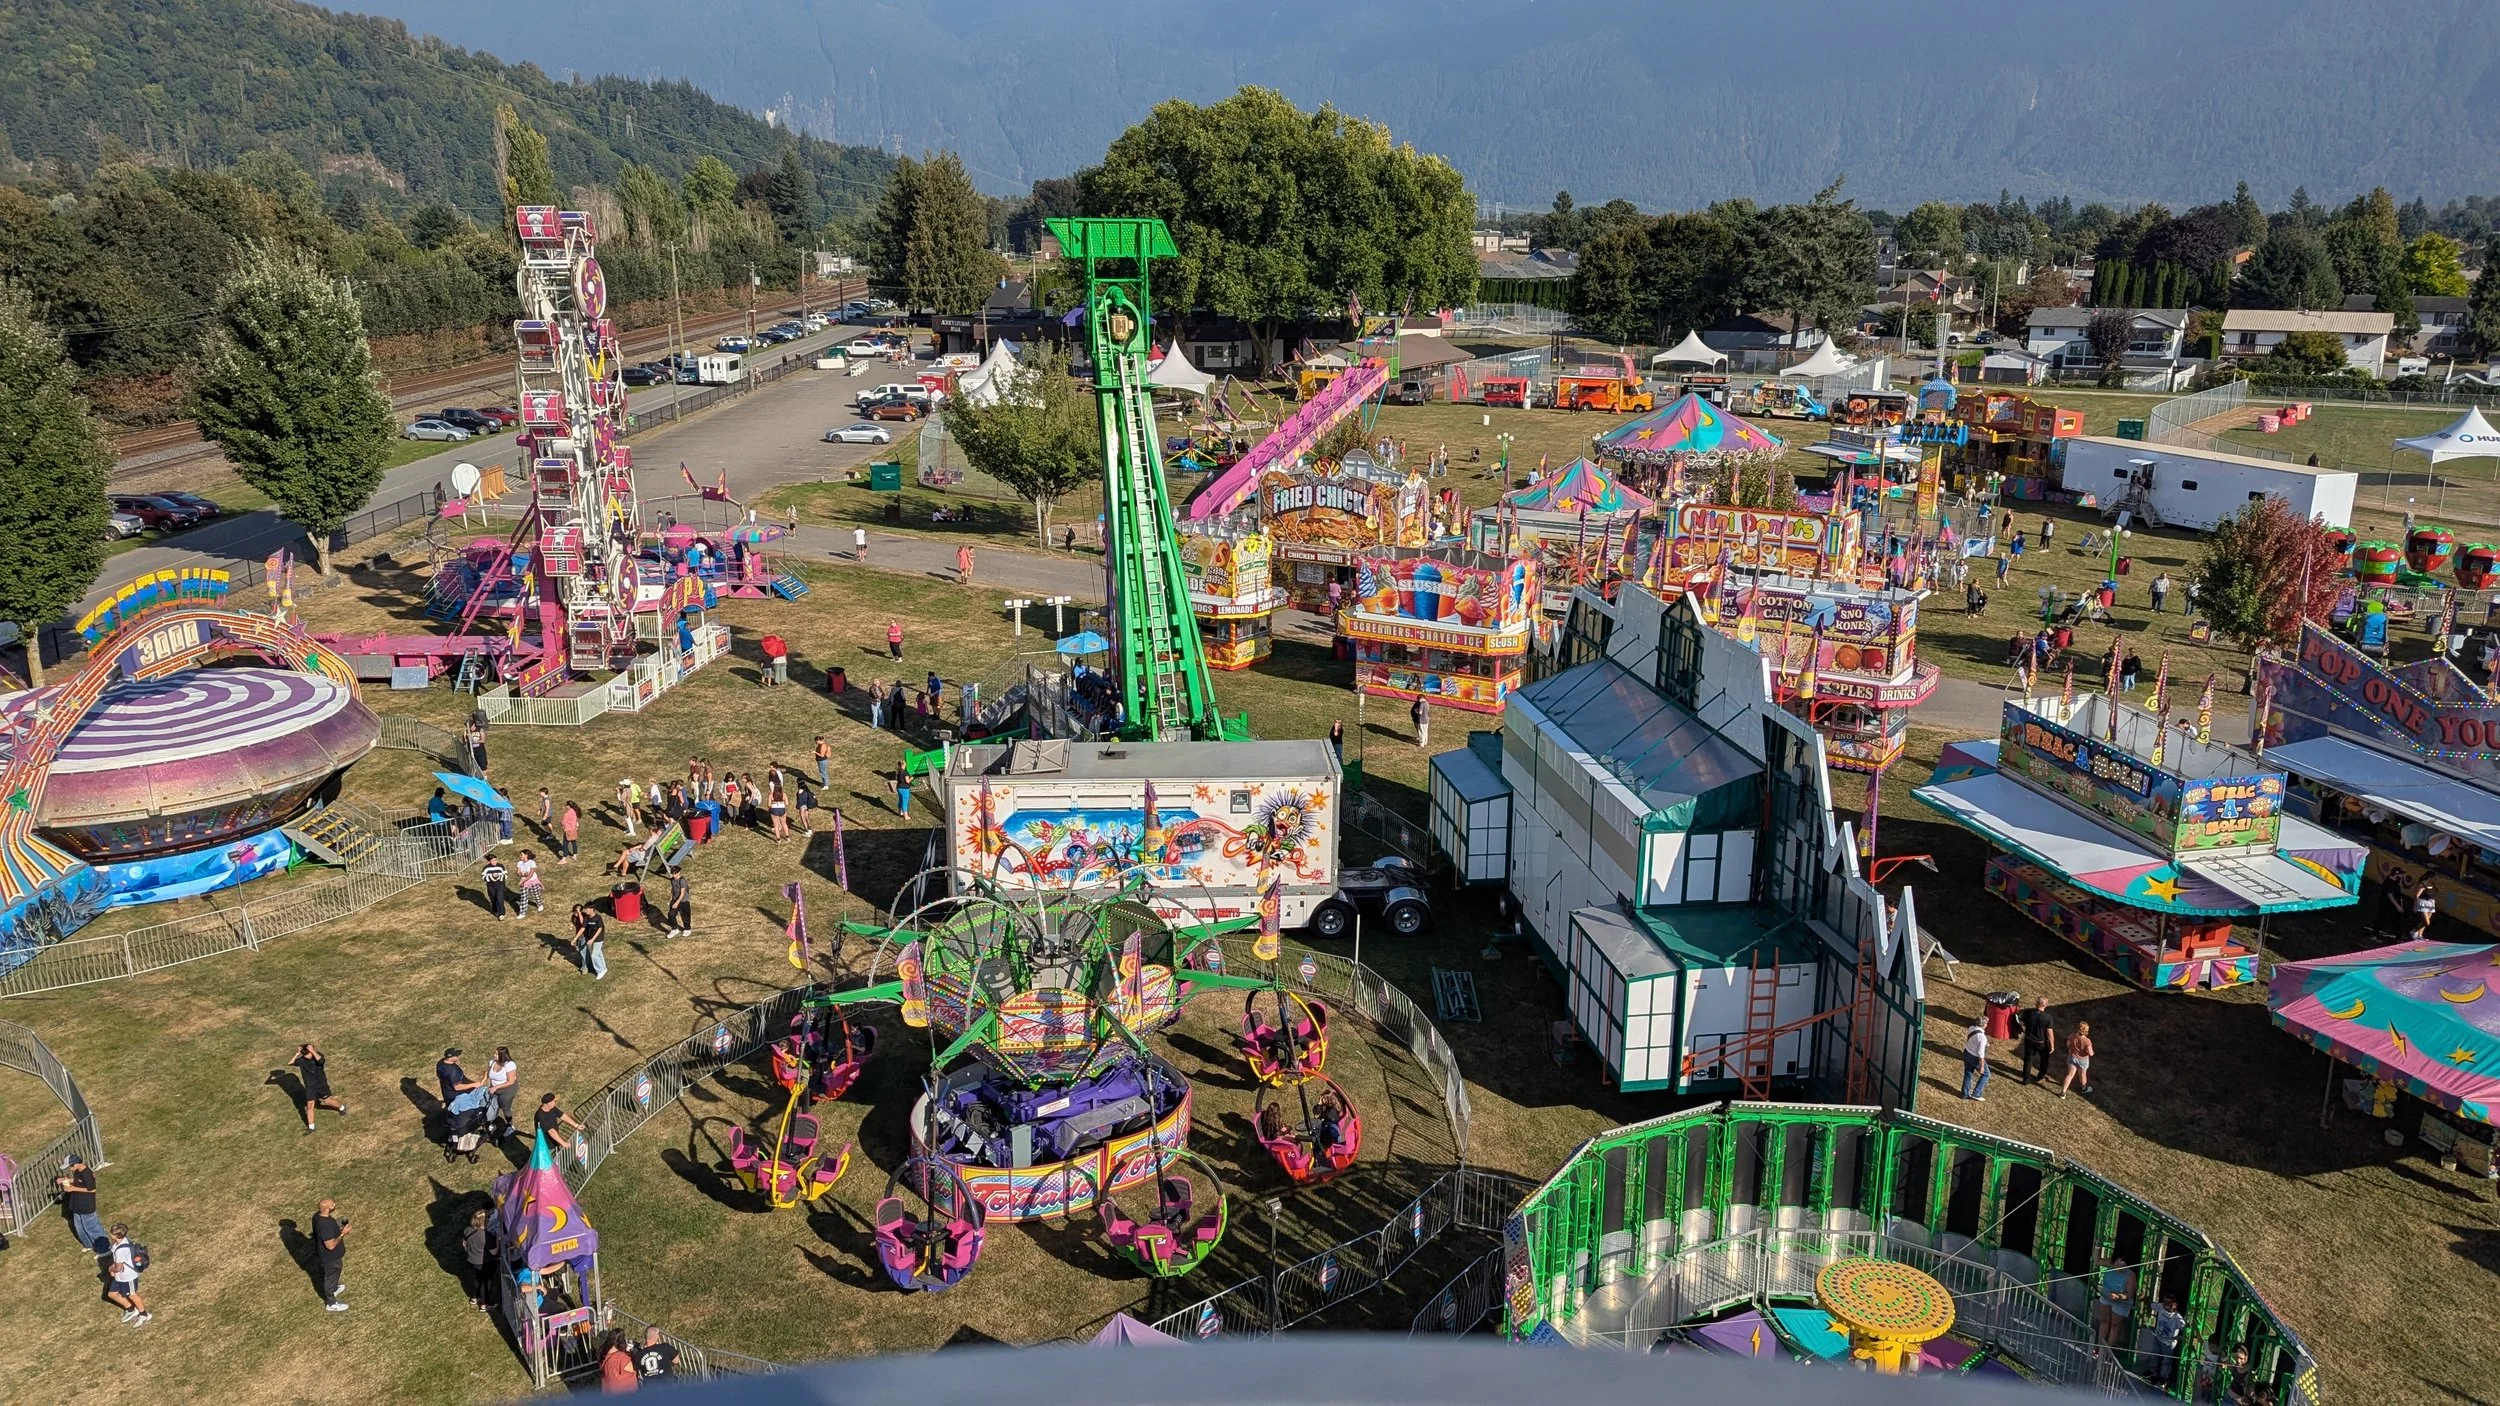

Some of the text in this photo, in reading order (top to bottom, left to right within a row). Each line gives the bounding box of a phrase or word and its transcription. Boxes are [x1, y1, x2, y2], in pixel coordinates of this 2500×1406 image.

[1273, 484, 1369, 519] FRIED CHICK
[1690, 509, 1816, 540] Mini Donuts
[1287, 551, 1344, 564] CHICKEN BURGER
[1192, 603, 1214, 614] DOGS
[1217, 605, 1254, 615] LEMONADE
[1257, 600, 1273, 613] CORN
[1758, 596, 1813, 612] COTTON
[1763, 608, 1808, 623] CANDY
[1840, 608, 1863, 619] SNO
[1835, 619, 1873, 632] KONES
[138, 620, 199, 665] 3000
[1419, 630, 1458, 645] SHAVED
[1463, 634, 1481, 648] ICE
[1489, 638, 1518, 649] SLUSH
[1880, 688, 1917, 701] DRINKS
[2303, 638, 2361, 686] POP
[2363, 678, 2429, 736] ONE
[2210, 785, 2256, 801] WHAC
[2205, 818, 2252, 836] MOLE!
[971, 1174, 1097, 1212] Tornado
[551, 1238, 579, 1255] ENTER
